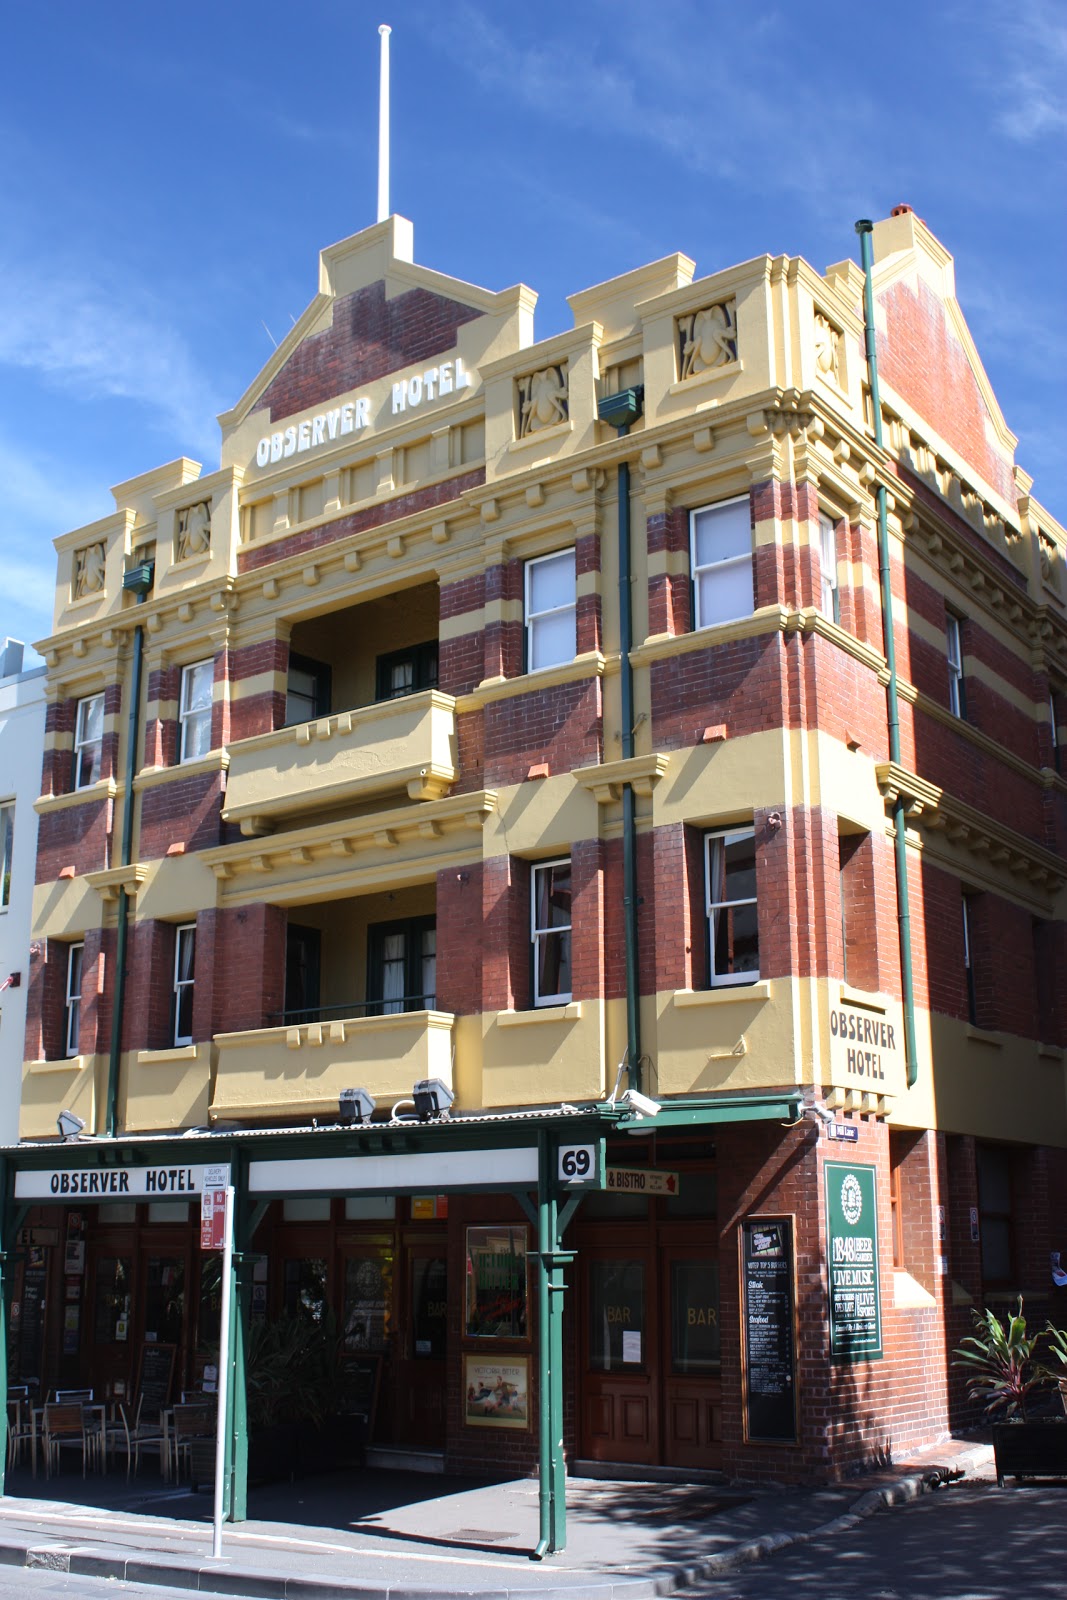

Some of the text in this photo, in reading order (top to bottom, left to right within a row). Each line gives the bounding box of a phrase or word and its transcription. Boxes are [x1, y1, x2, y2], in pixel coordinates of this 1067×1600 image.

[256, 358, 471, 468] OBSERVER HOTEL
[830, 1010, 896, 1050] OBSERVER
[847, 1048, 885, 1080] HOTEL
[845, 1127, 854, 1137] Lane
[562, 1149, 590, 1176] 69
[51, 1169, 195, 1194] OBSERVER HOTEL
[608, 1171, 615, 1187] &
[617, 1172, 646, 1190] BISTRO
[216, 1193, 223, 1203] NO
[834, 1236, 855, 1262] 1848
[856, 1237, 873, 1252] BEER
[833, 1270, 874, 1286] LIVE MUSIC
[844, 1302, 854, 1312] LATE
[860, 1292, 875, 1306] LIVE
[427, 1302, 447, 1318] BAR
[607, 1305, 631, 1323] BAR
[687, 1307, 717, 1325] BAR
[859, 1306, 876, 1317] SPORTS
